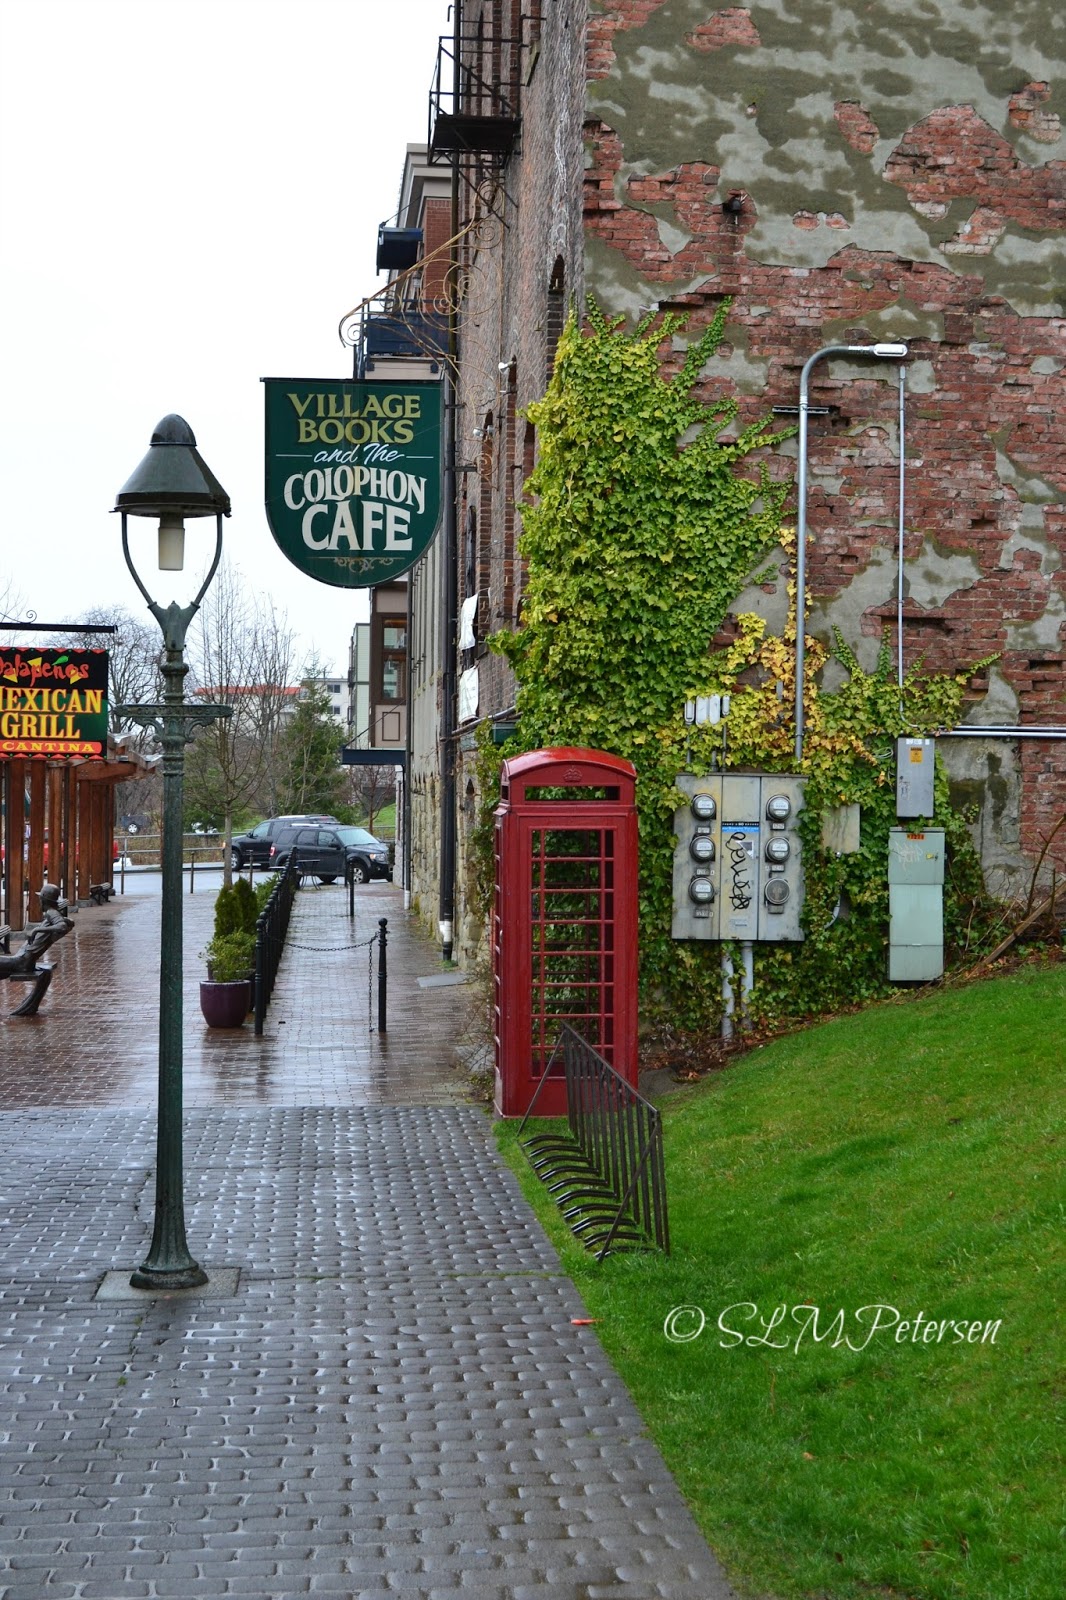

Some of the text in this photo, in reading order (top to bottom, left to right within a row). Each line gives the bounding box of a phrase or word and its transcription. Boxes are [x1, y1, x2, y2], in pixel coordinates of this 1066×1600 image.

[286, 393, 421, 419] VILLAGE
[298, 418, 414, 444] BOOKS
[313, 442, 405, 465] and The
[283, 465, 428, 514] COLOPHON
[301, 500, 413, 551] CAFE
[1, 712, 80, 739] GRILL
[2, 742, 94, 752] CANTINA
